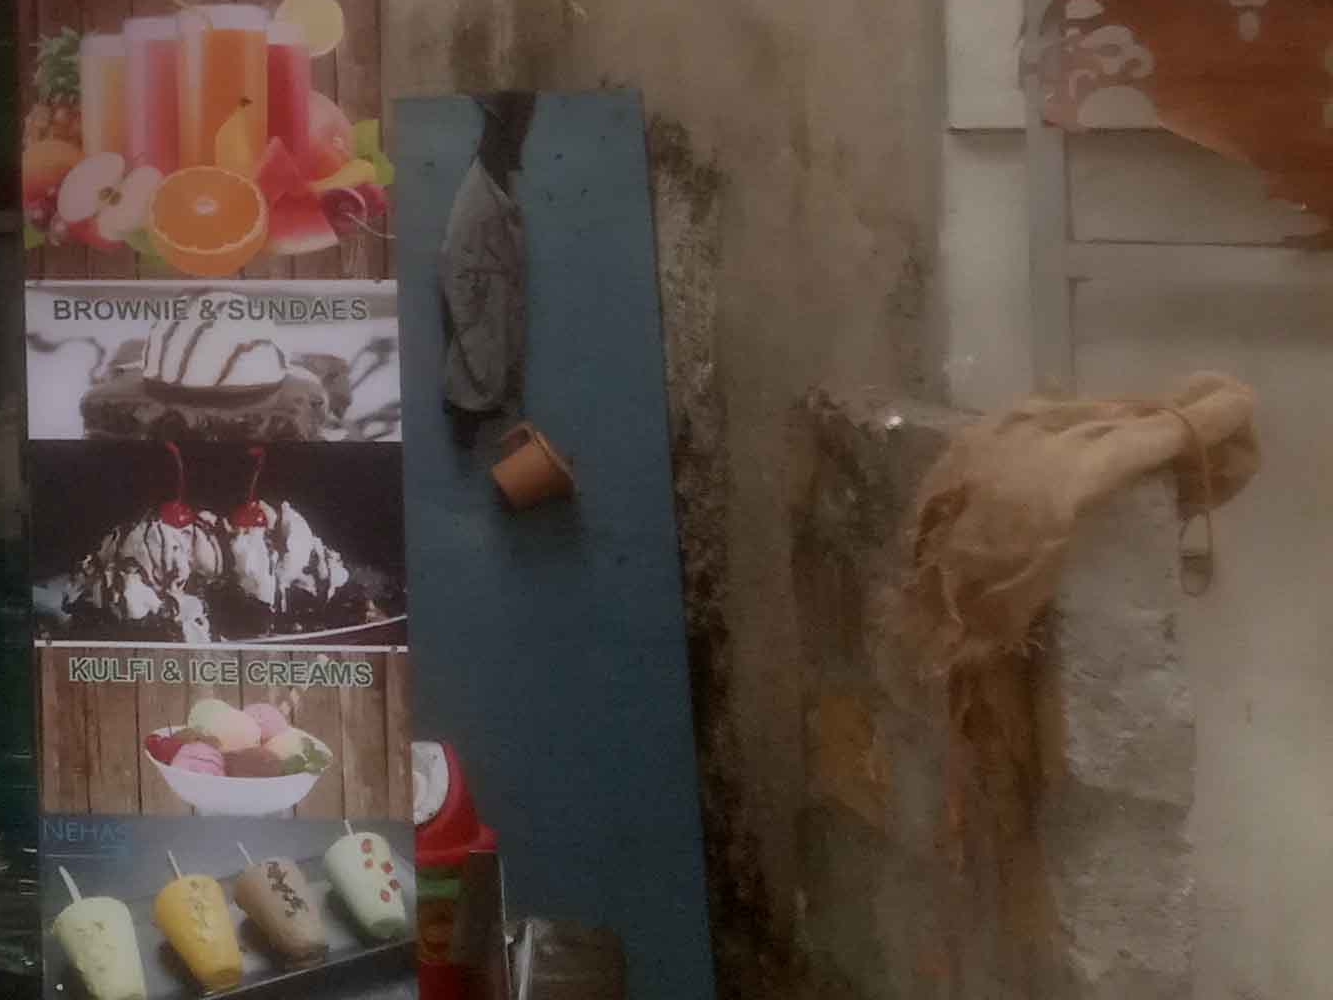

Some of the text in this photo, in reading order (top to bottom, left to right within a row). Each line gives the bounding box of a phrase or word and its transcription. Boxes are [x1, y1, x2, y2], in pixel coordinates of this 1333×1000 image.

[53, 299, 368, 321] BROWNIE & SUNDAES
[68, 657, 374, 687] KULFI & ICE CREAMS
